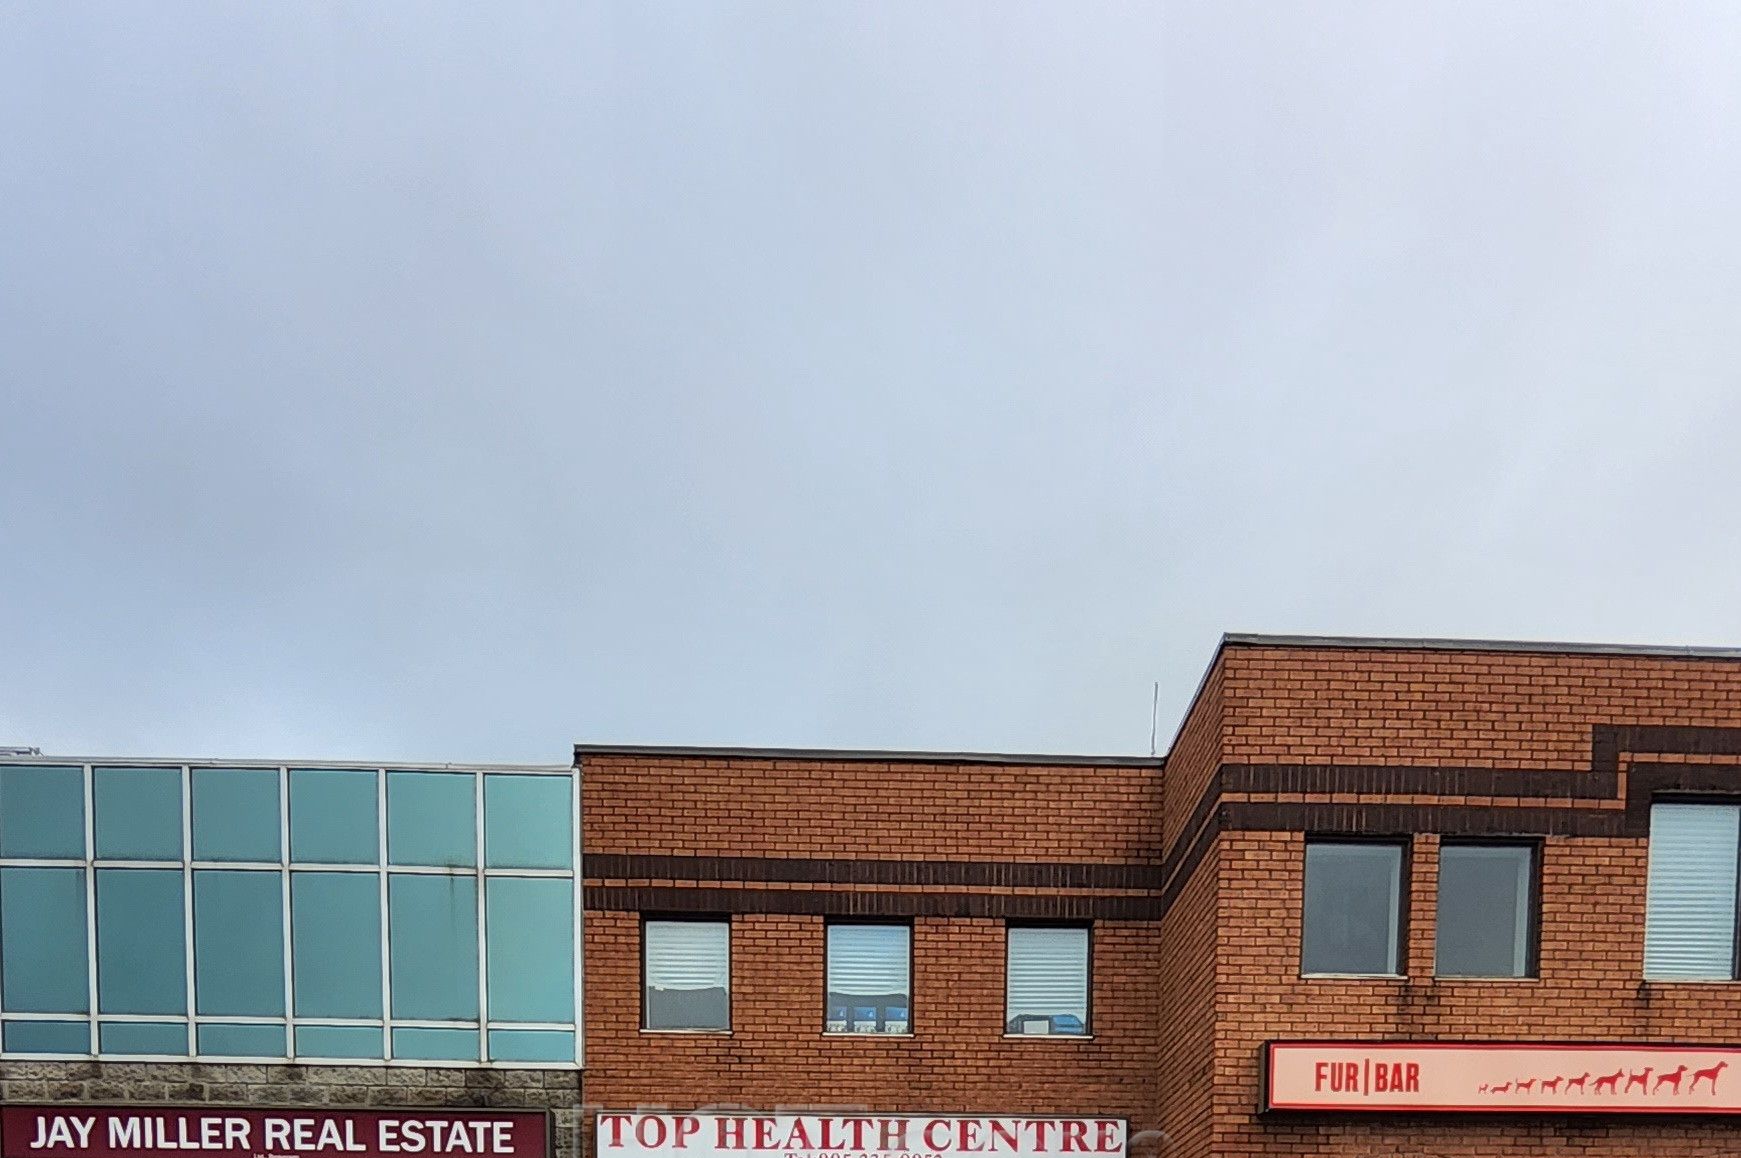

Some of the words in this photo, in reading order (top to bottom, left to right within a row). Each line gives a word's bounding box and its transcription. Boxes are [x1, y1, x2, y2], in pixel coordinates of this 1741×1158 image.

[30, 1116, 96, 1150] JAY
[108, 1116, 253, 1151] MILLER
[264, 1118, 367, 1152] REAL
[378, 1120, 516, 1154] ESTATE
[599, 1115, 701, 1149] TOP
[713, 1117, 910, 1152] HEALTH
[922, 1119, 1123, 1153] CENTRE
